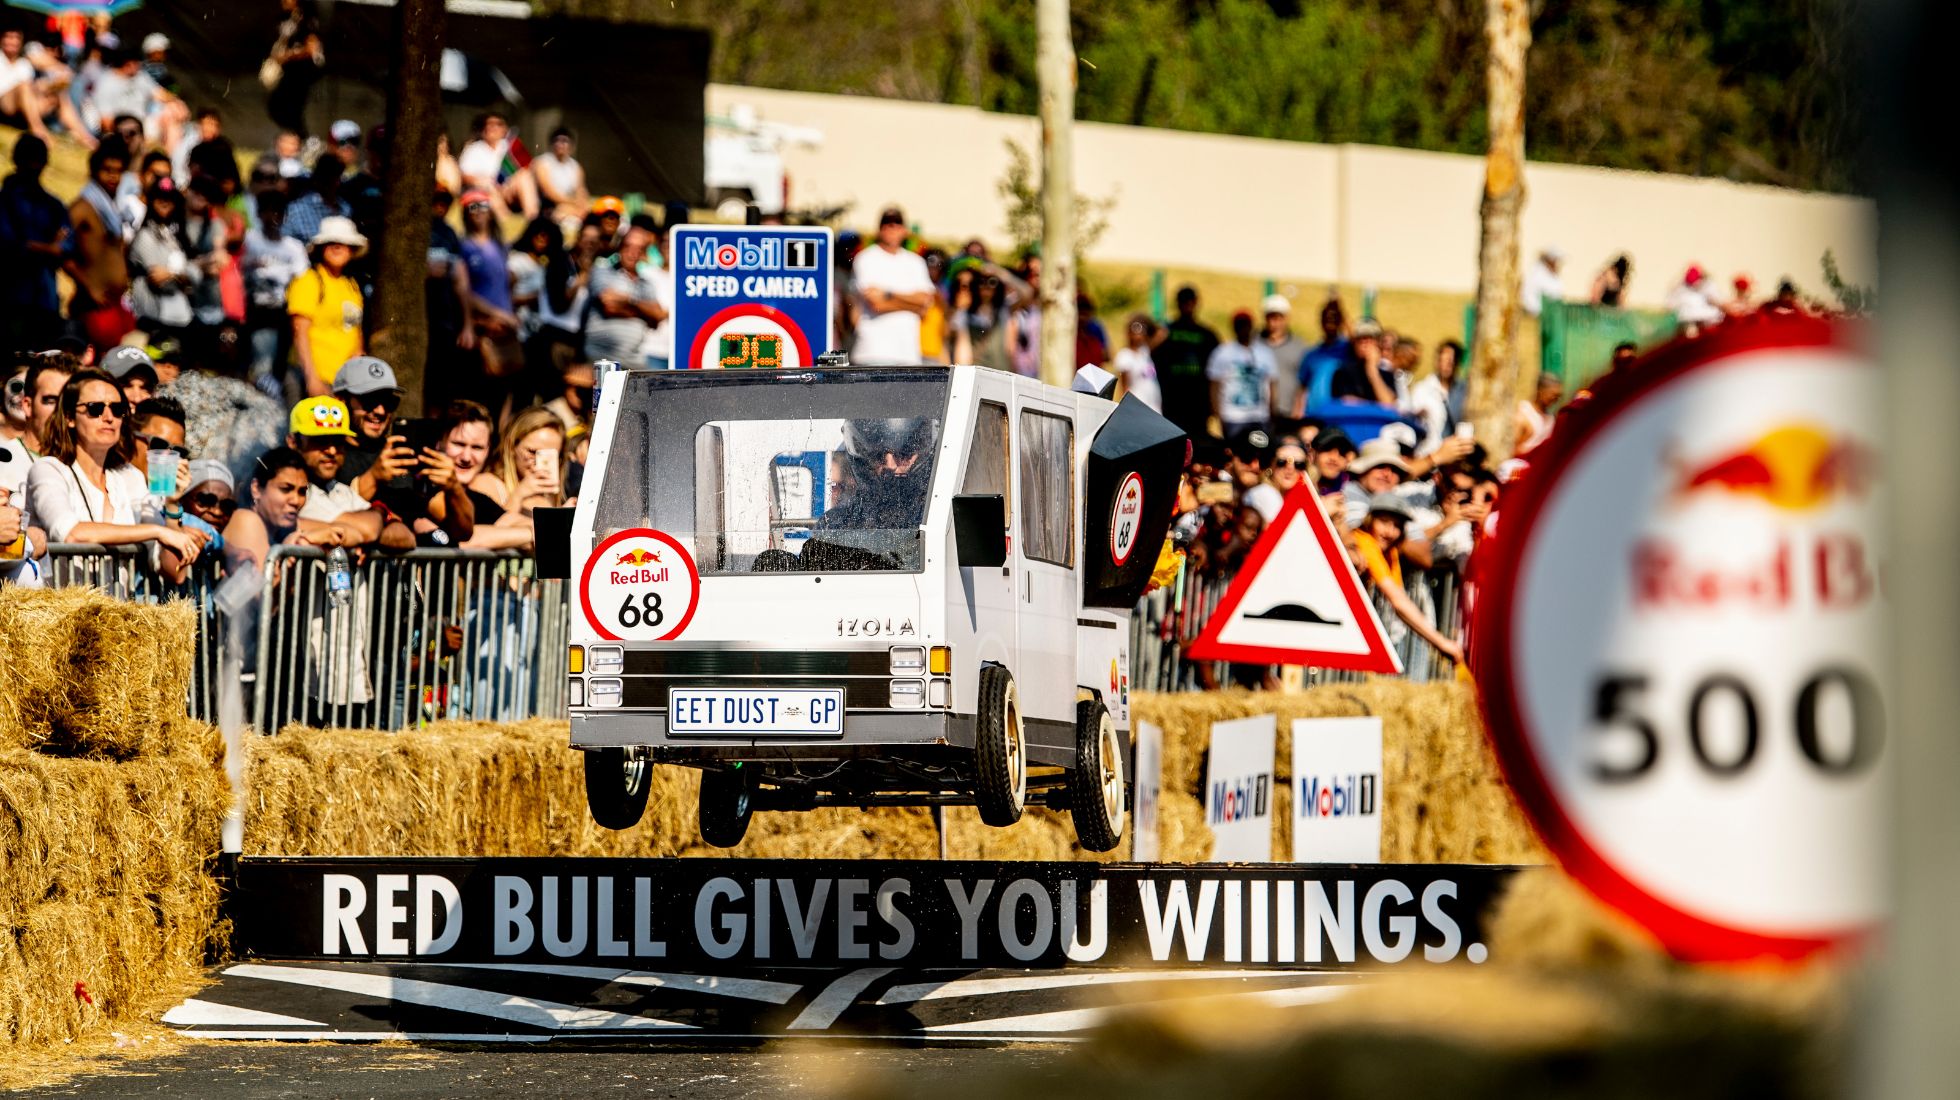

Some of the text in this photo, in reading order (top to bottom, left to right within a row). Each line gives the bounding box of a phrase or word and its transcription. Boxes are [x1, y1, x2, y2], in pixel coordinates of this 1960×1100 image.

[685, 237, 781, 271] Mobil
[685, 275, 818, 299] SPEED CAMERA
[1118, 521, 1131, 548] 68
[610, 568, 669, 585] Red Bull
[618, 592, 664, 628] 68
[675, 697, 836, 725] EET DUST GP
[1587, 664, 1887, 786] 500
[1213, 775, 1253, 825] Mobil
[1301, 775, 1355, 817] Mobil
[322, 873, 1489, 965] RED BULL GIVES YOU WIIINGS.
